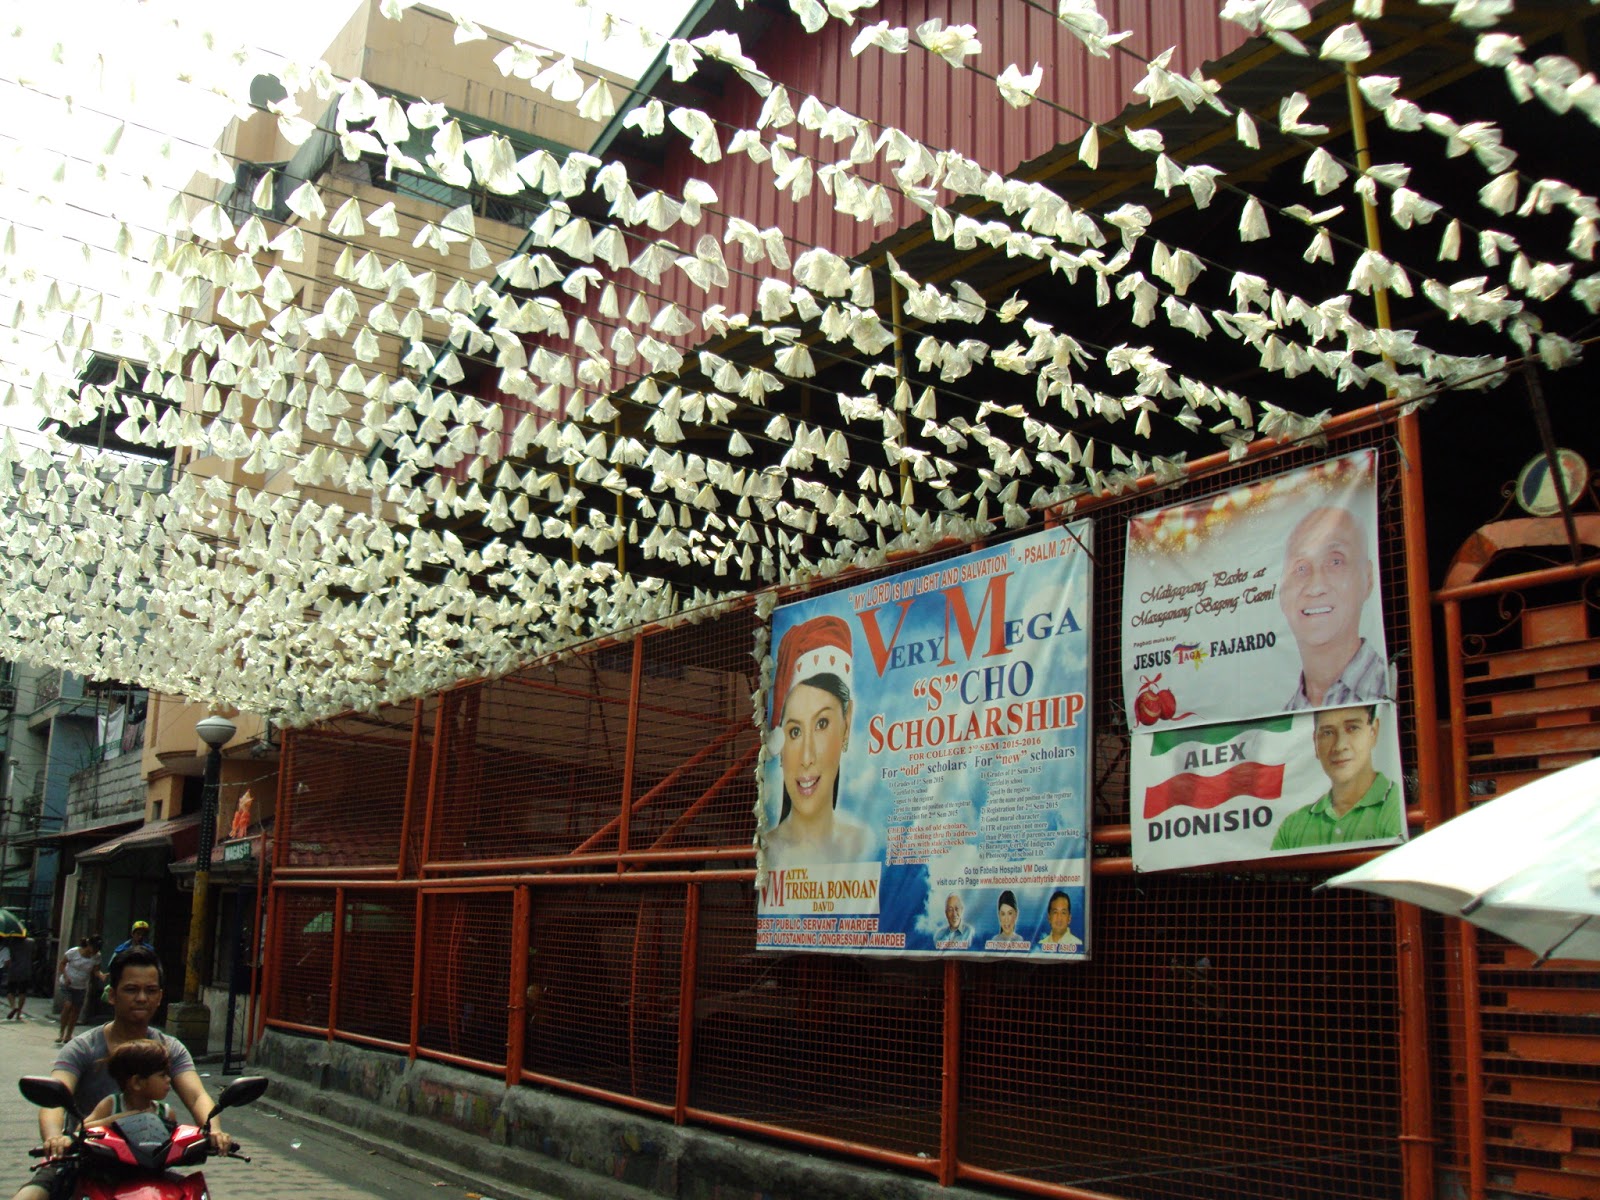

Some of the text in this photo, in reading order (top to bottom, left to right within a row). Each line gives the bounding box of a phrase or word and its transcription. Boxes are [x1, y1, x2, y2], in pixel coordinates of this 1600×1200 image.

[867, 582, 890, 606] LORD
[892, 586, 900, 600] IS
[903, 581, 914, 597] MY
[916, 573, 940, 594] LIGHT
[942, 568, 958, 586] AND
[1024, 540, 1056, 565] PSALM
[1213, 568, 1249, 588] Pasko
[1253, 567, 1267, 579] at
[1194, 596, 1239, 616] Bagong
[856, 571, 1082, 678] VERY MEGA
[1133, 650, 1171, 670] JESUS
[1210, 631, 1276, 658] FAJARDO
[868, 693, 1084, 754] SCHOLARSHIP
[909, 752, 924, 762] FOR
[926, 746, 966, 760] COLLEGE
[980, 741, 1000, 752] SEM
[1002, 736, 1042, 750] 2015-2016
[974, 754, 992, 768] For
[1030, 746, 1075, 762] scholars
[1184, 742, 1246, 770] ALEX
[882, 767, 898, 779] For
[927, 760, 968, 774] scholars
[986, 806, 1015, 814] Registration
[1015, 813, 1040, 821] character
[1003, 823, 1021, 832] parents
[1148, 805, 1273, 842] DIONISIO
[1026, 831, 1045, 840] parents
[1056, 829, 1079, 838] working
[1030, 840, 1055, 848] Indigency
[786, 868, 808, 880] ATTY.
[964, 867, 972, 875] Go
[980, 866, 998, 874] Fabella
[1000, 865, 1022, 875] Hospital
[1023, 864, 1033, 873] VM
[1034, 864, 1048, 872] Desk
[936, 878, 948, 886] visit
[958, 877, 964, 885] Fb
[965, 877, 979, 886] Page
[785, 880, 878, 900] TRISHA BONOAN
[812, 901, 834, 912] DAVID
[757, 918, 879, 931] BEST PUBLIC SERVANT AWARDEE
[773, 933, 816, 945] OUTSTANDING
[818, 934, 869, 946] CONGRESSMAN
[870, 934, 905, 947] AWARDEE
[1042, 943, 1058, 951] OBET
